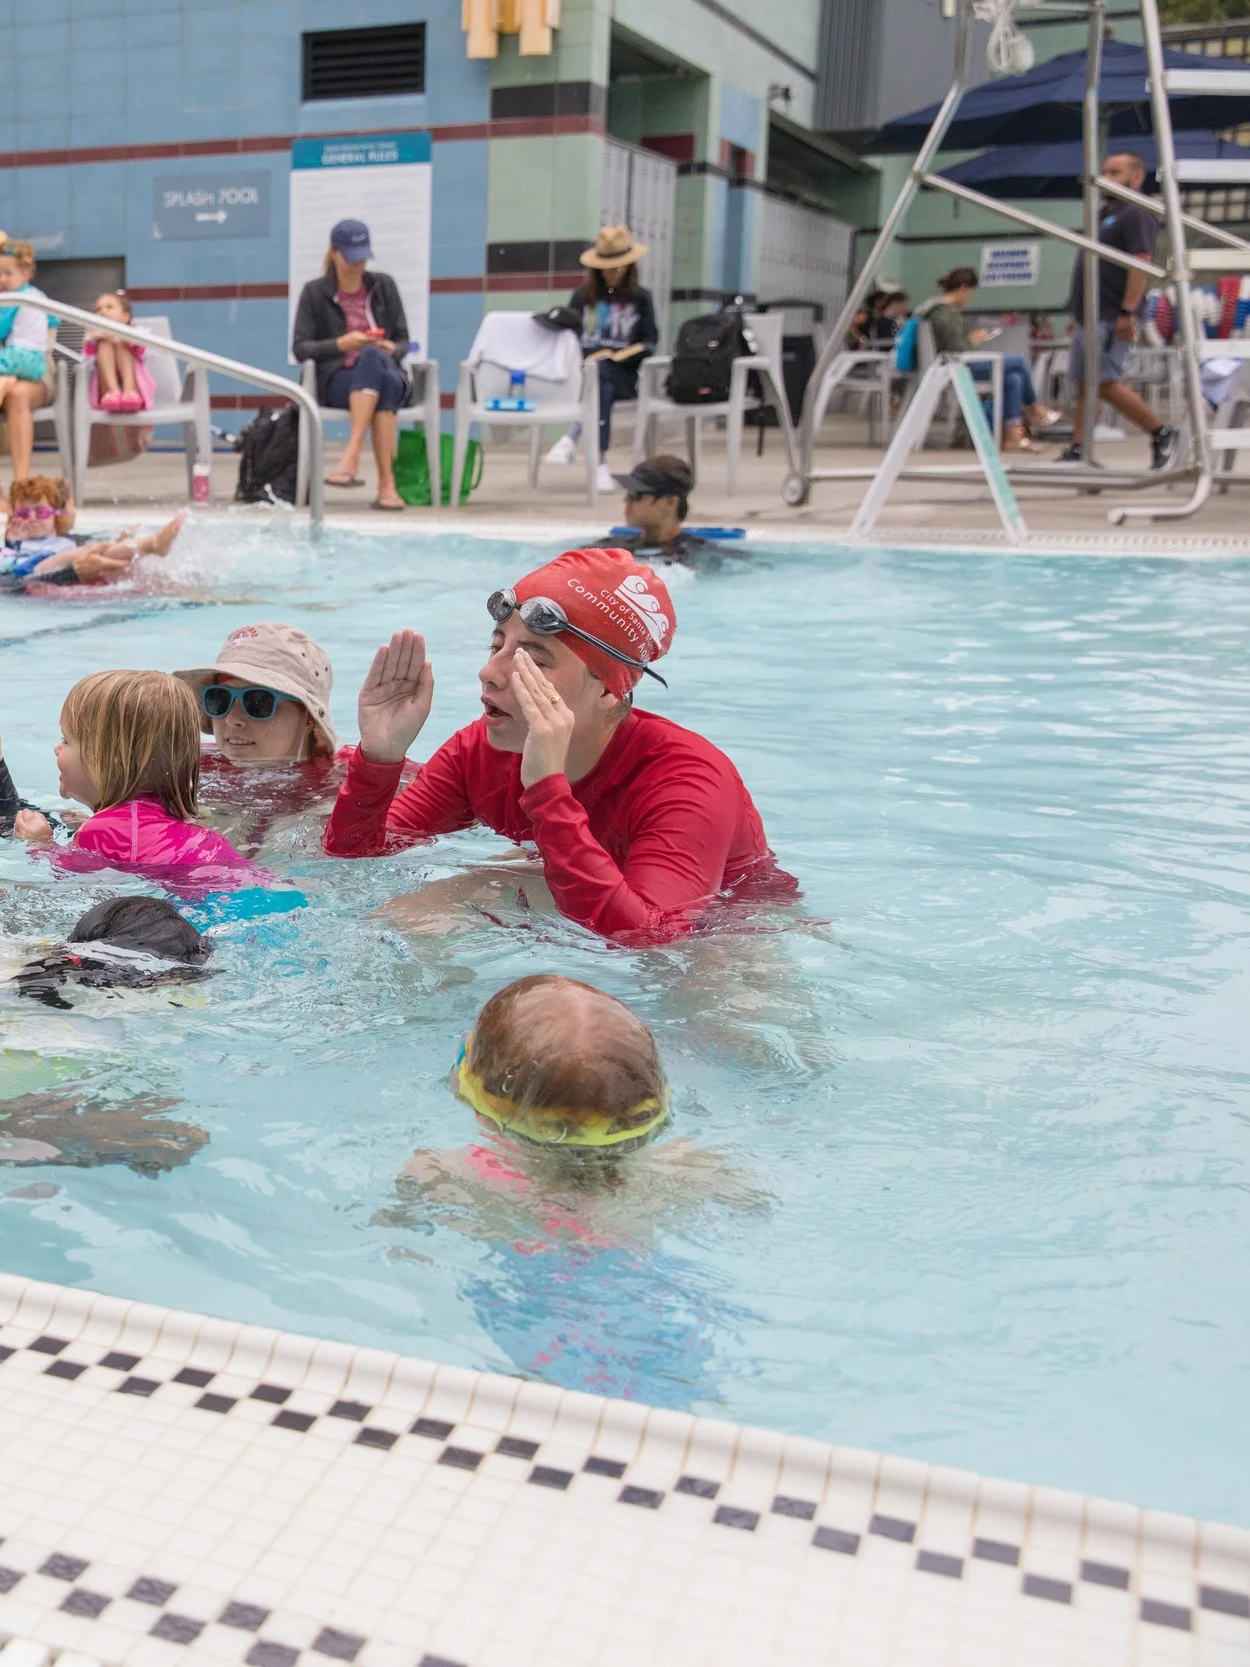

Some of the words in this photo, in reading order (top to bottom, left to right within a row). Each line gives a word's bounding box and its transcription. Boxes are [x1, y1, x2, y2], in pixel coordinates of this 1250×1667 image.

[164, 190, 215, 208] SPLASH
[218, 187, 258, 205] POOL
[567, 579, 639, 642] Community
[600, 589, 619, 605] City
[619, 605, 631, 614] of
[628, 612, 646, 635] Santa
